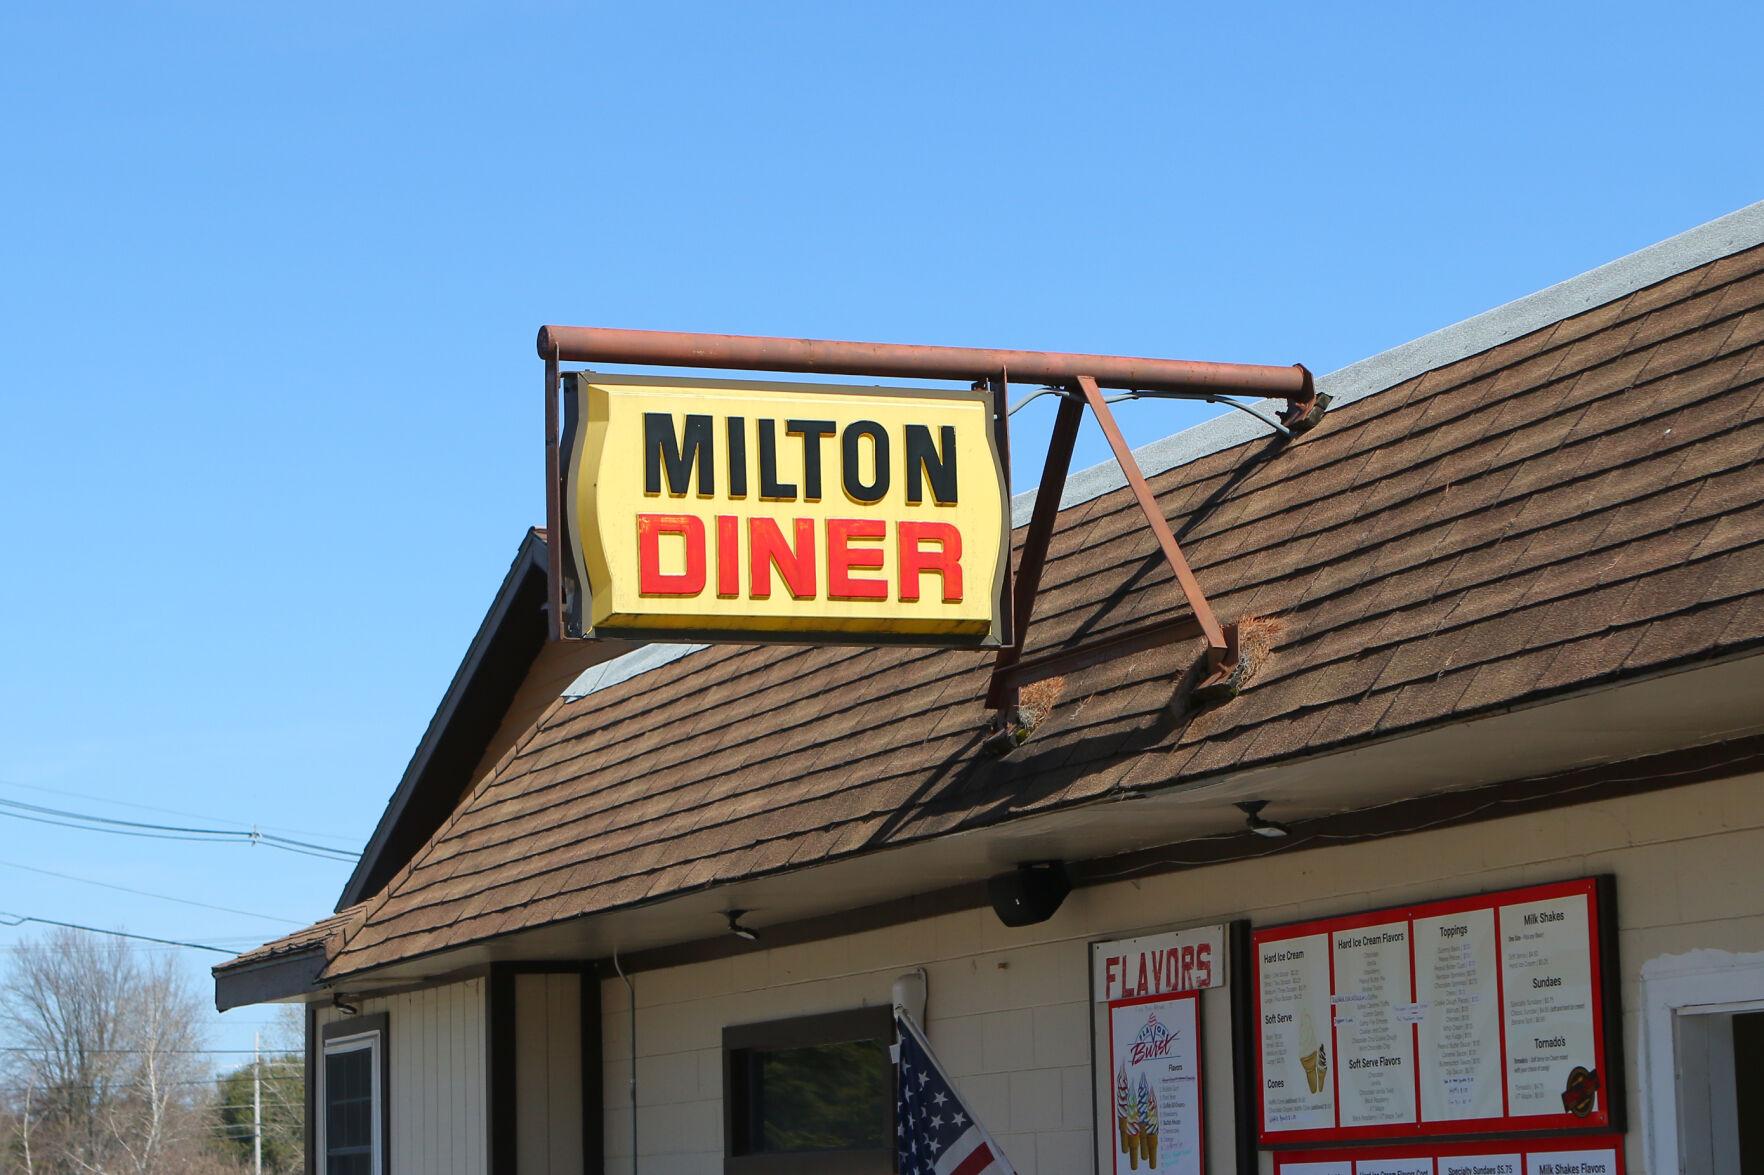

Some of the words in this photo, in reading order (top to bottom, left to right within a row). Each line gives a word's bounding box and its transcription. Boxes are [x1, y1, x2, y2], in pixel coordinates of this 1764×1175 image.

[642, 411, 958, 505] MILTON
[636, 513, 963, 603] DINER
[1524, 915, 1539, 925] Milk
[1540, 911, 1564, 923] Shakes
[1440, 925, 1467, 938] Toppings
[1338, 938, 1352, 949] Hard
[1352, 937, 1362, 947] Ice
[1362, 935, 1382, 946] Cream
[1382, 931, 1404, 943] Flavors
[1264, 953, 1277, 964] Hard
[1277, 952, 1286, 962] Ice
[1286, 950, 1304, 961] Cream
[1105, 943, 1212, 999] FLAVORS
[1532, 975, 1562, 989] Sundaes
[1265, 1014, 1276, 1025] Soft
[1276, 1013, 1293, 1023] Serve
[1130, 1030, 1180, 1066] Burst
[1534, 1035, 1566, 1049] Tornado's
[1349, 1058, 1361, 1069] Soft
[1361, 1057, 1379, 1067] Serve
[1379, 1056, 1401, 1066] Flavors
[1267, 1079, 1284, 1089] Cones
[1448, 1166, 1472, 1175] Specialty
[1473, 1165, 1496, 1175] Sundaes
[1539, 1164, 1553, 1174] Milk
[1554, 1163, 1580, 1175] Shakes
[1580, 1162, 1606, 1174] Flavors
